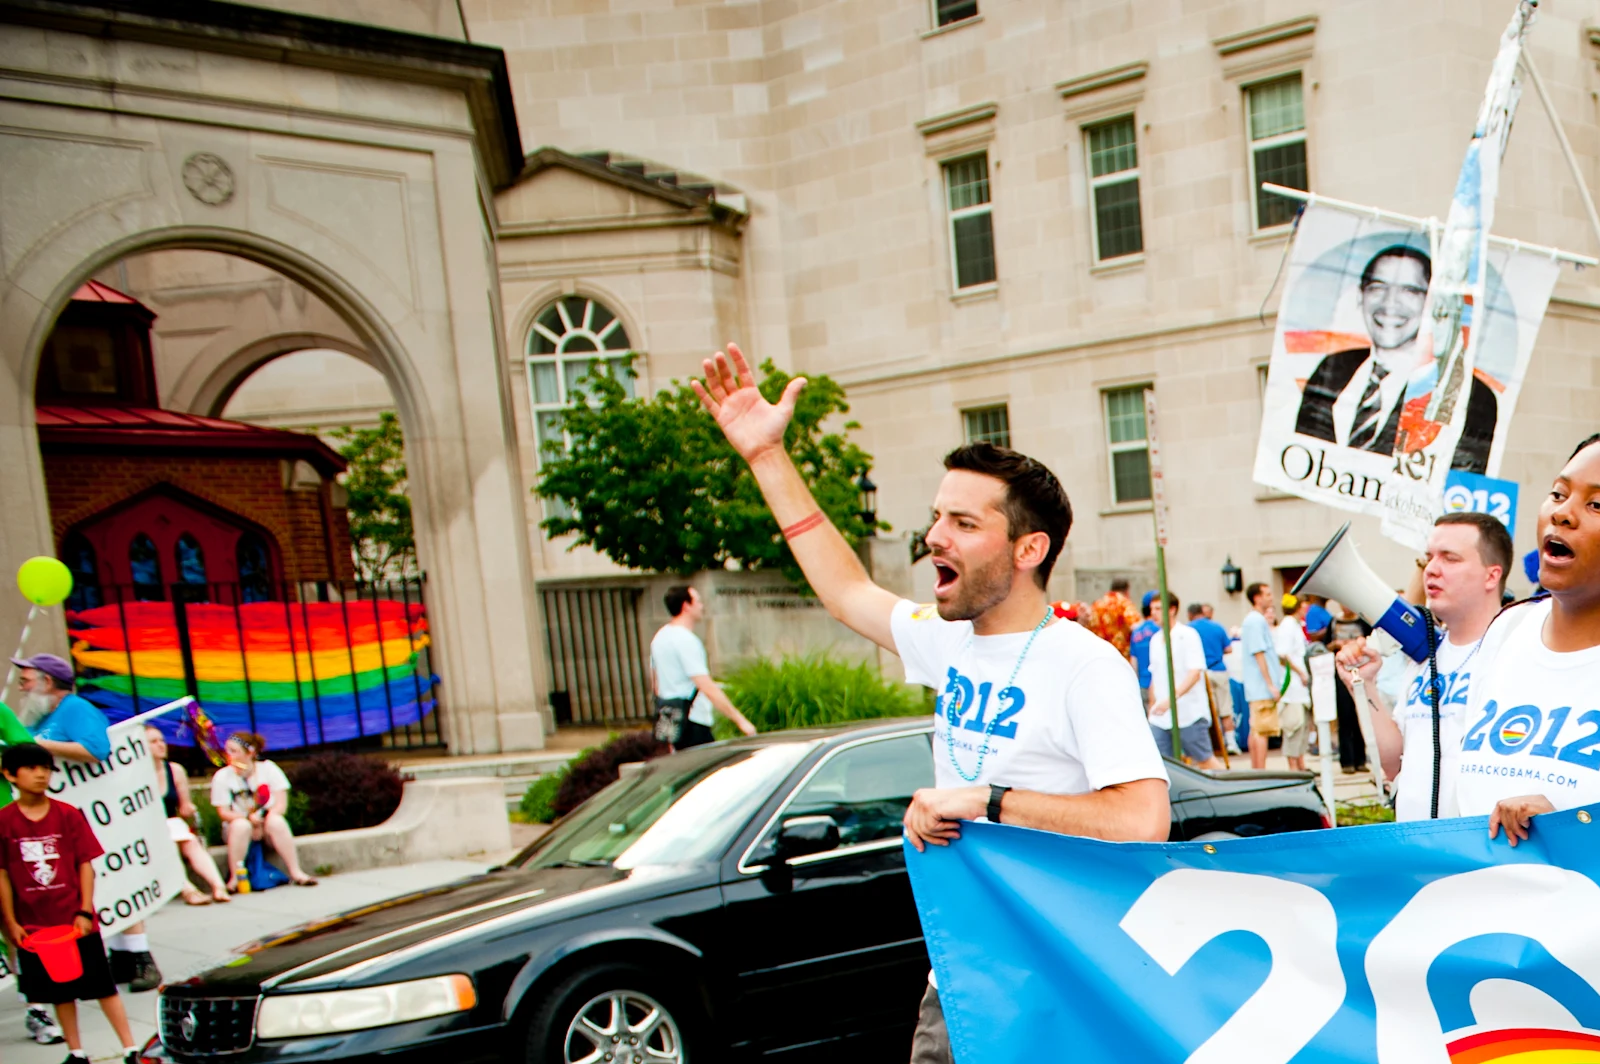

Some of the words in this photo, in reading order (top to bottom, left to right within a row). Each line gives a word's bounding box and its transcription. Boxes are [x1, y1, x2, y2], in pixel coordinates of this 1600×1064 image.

[1281, 444, 1385, 502] Obam
[1444, 485, 1511, 526] 012
[1461, 764, 1578, 789] BARACKOBAMA.COM
[119, 784, 153, 816] am
[101, 837, 151, 877] .org
[97, 879, 162, 927] come
